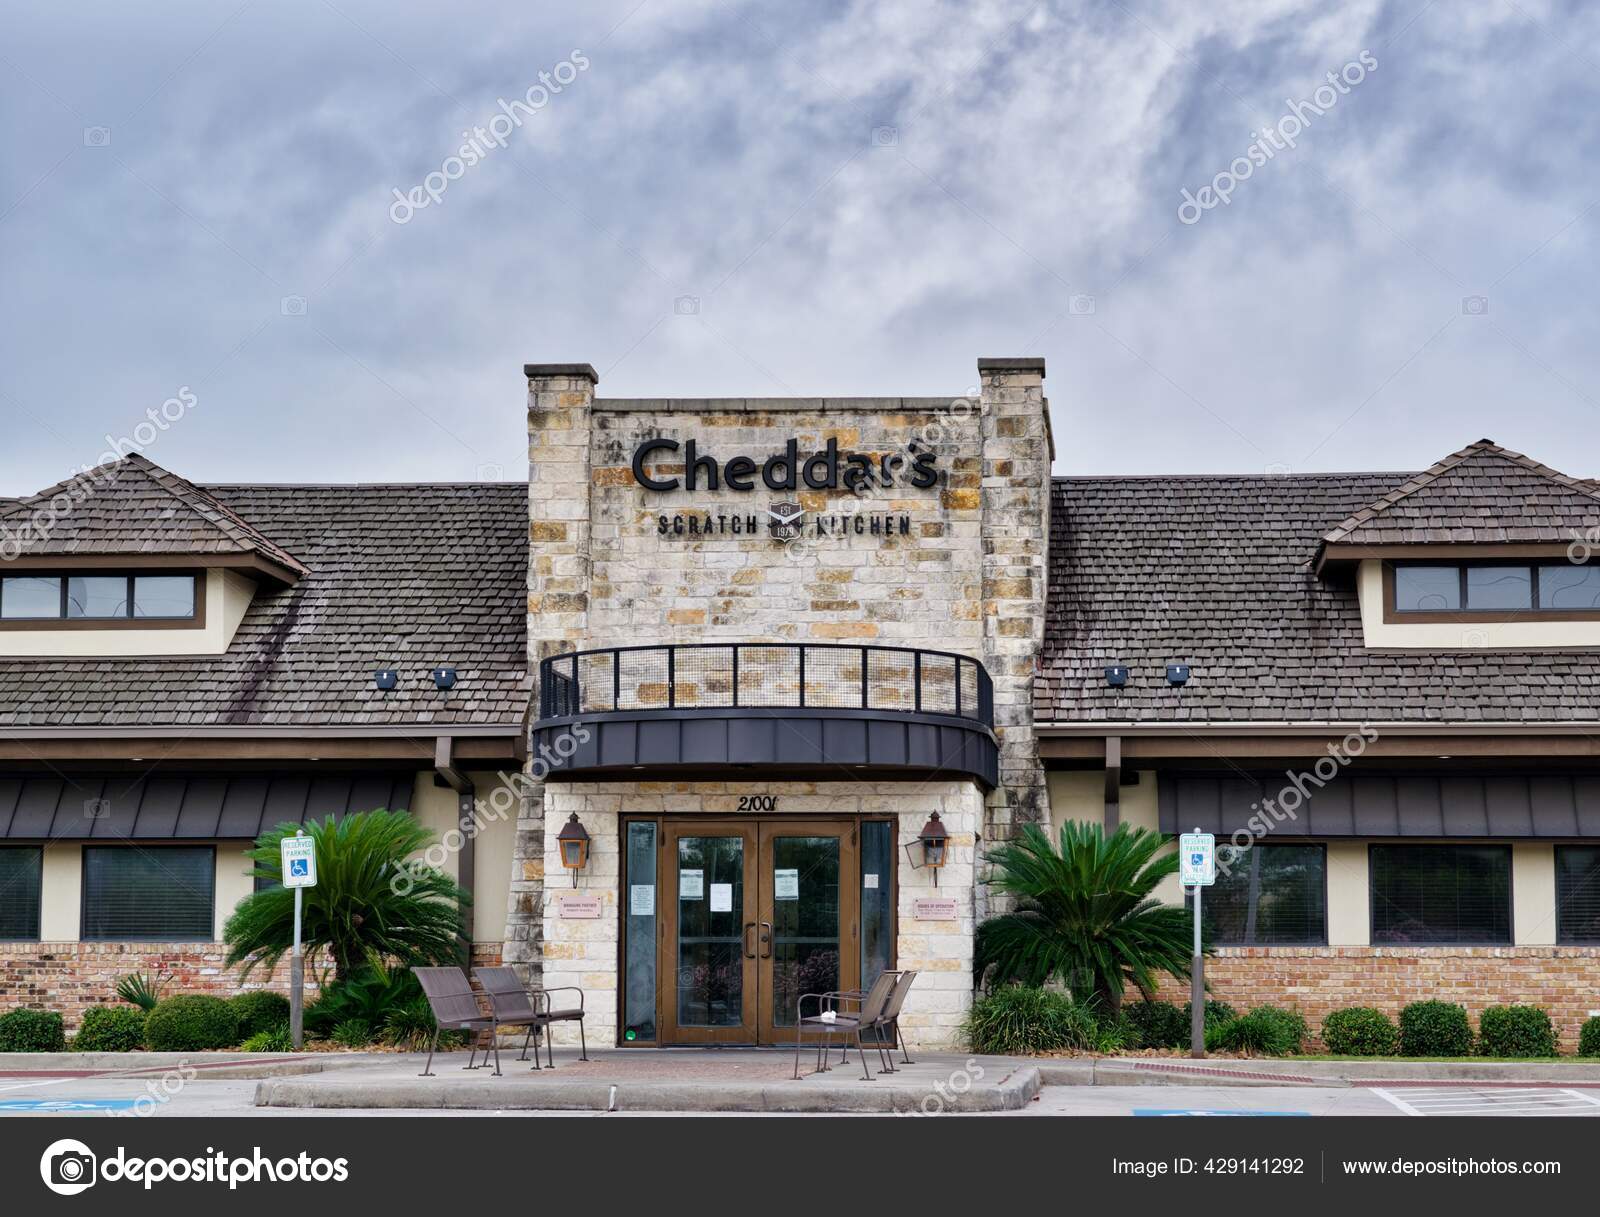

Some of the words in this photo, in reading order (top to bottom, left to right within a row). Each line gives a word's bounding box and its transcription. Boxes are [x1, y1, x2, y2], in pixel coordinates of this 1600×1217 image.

[632, 438, 938, 491] Cheddar's
[657, 515, 757, 534] SCRATCH
[816, 515, 911, 534] KITCHEN
[737, 796, 777, 811] 21001
